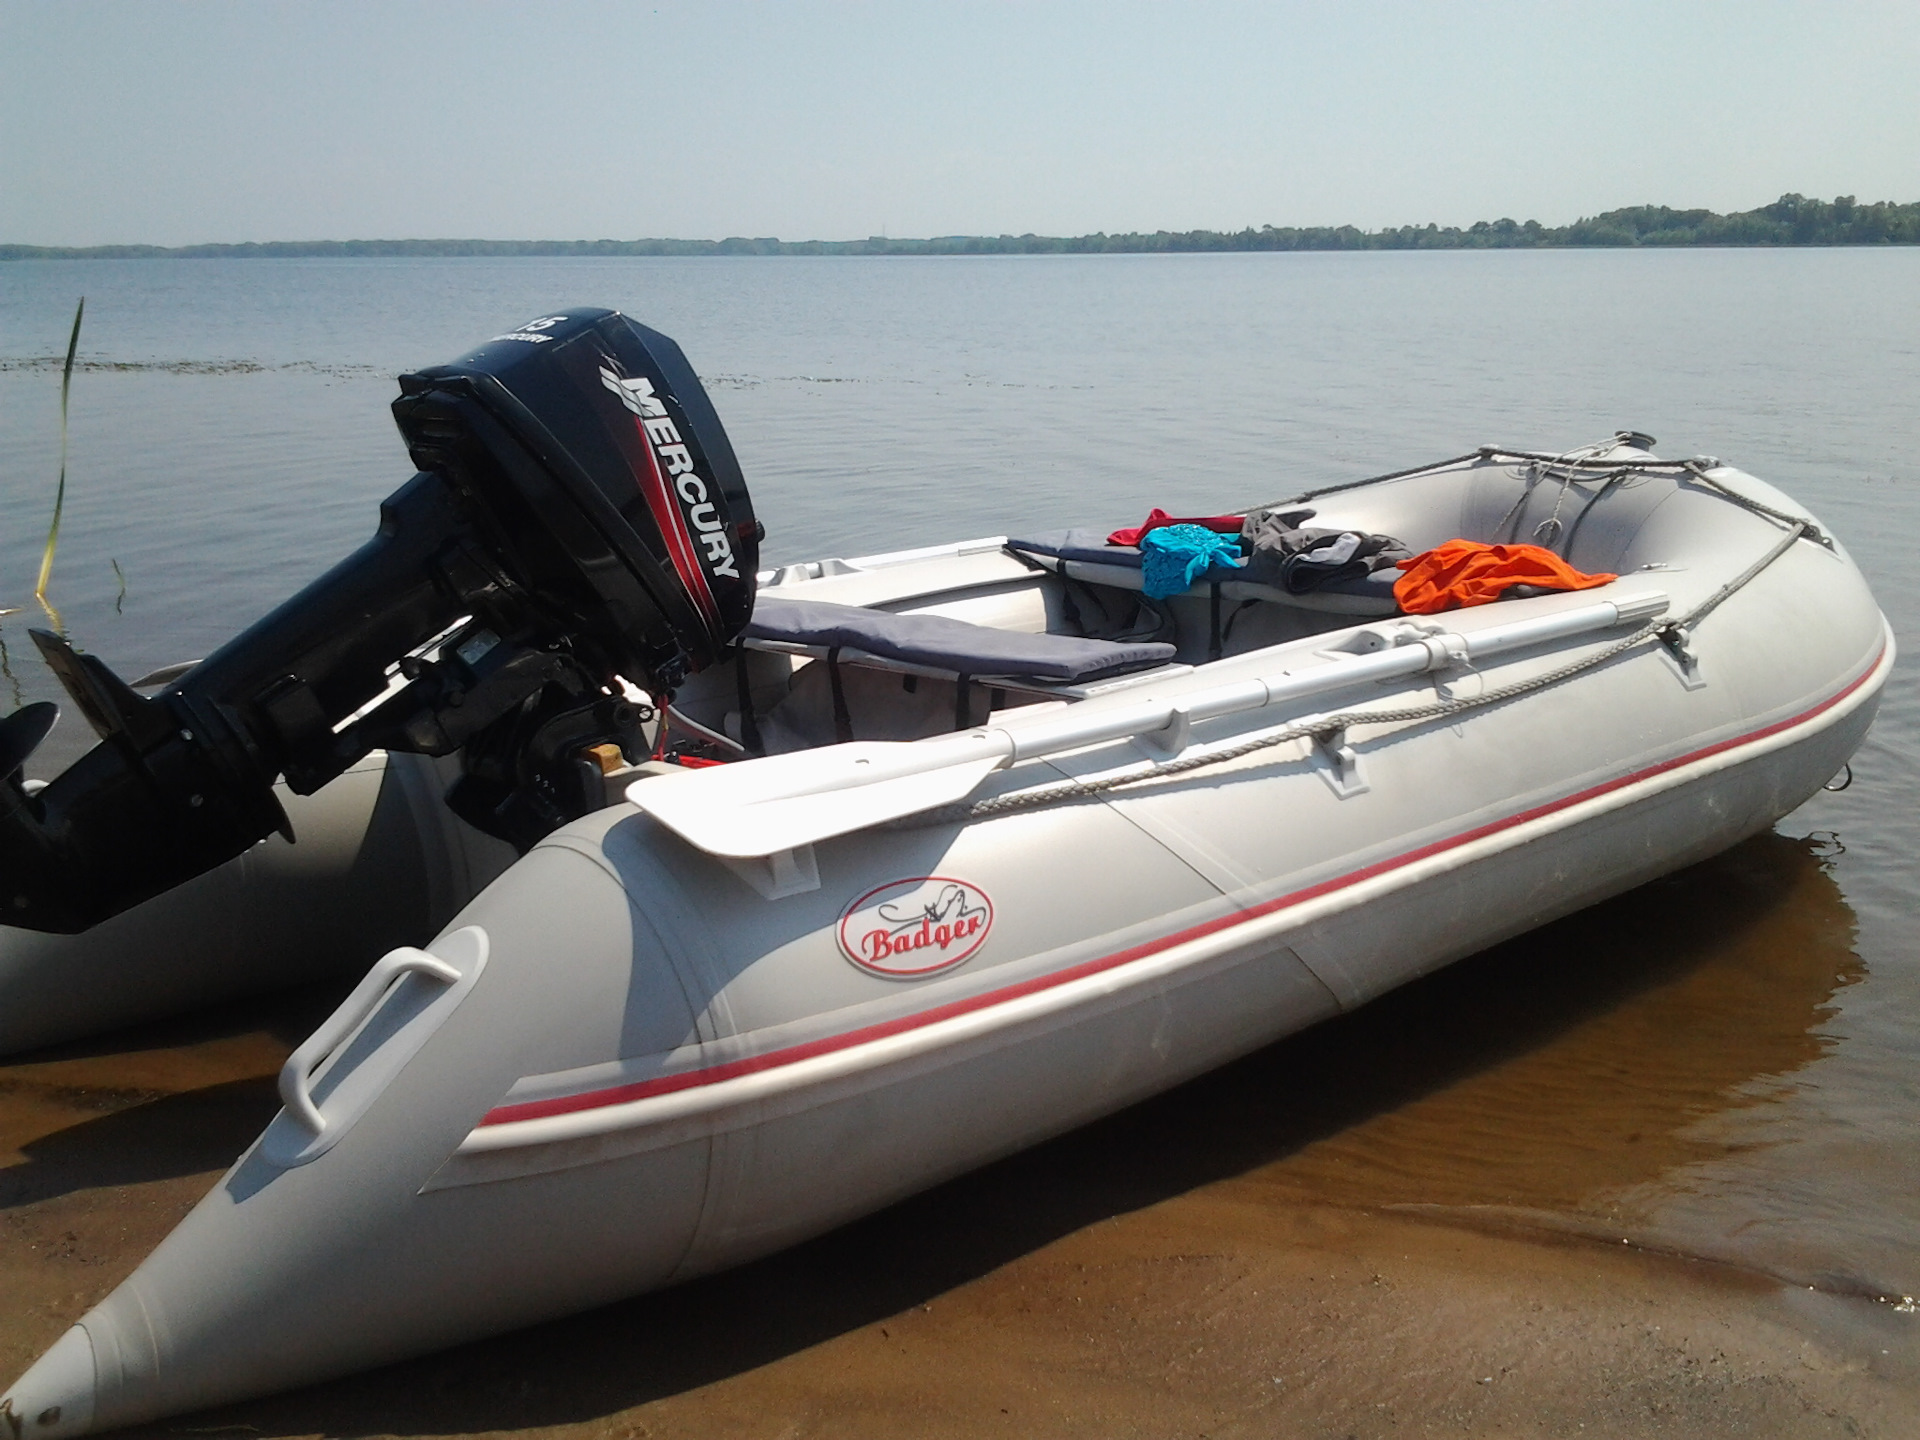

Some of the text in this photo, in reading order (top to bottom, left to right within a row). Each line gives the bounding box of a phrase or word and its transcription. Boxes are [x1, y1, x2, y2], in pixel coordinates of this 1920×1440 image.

[515, 316, 568, 332] 15
[618, 377, 740, 580] MERCURY
[861, 915, 981, 962] Badger
